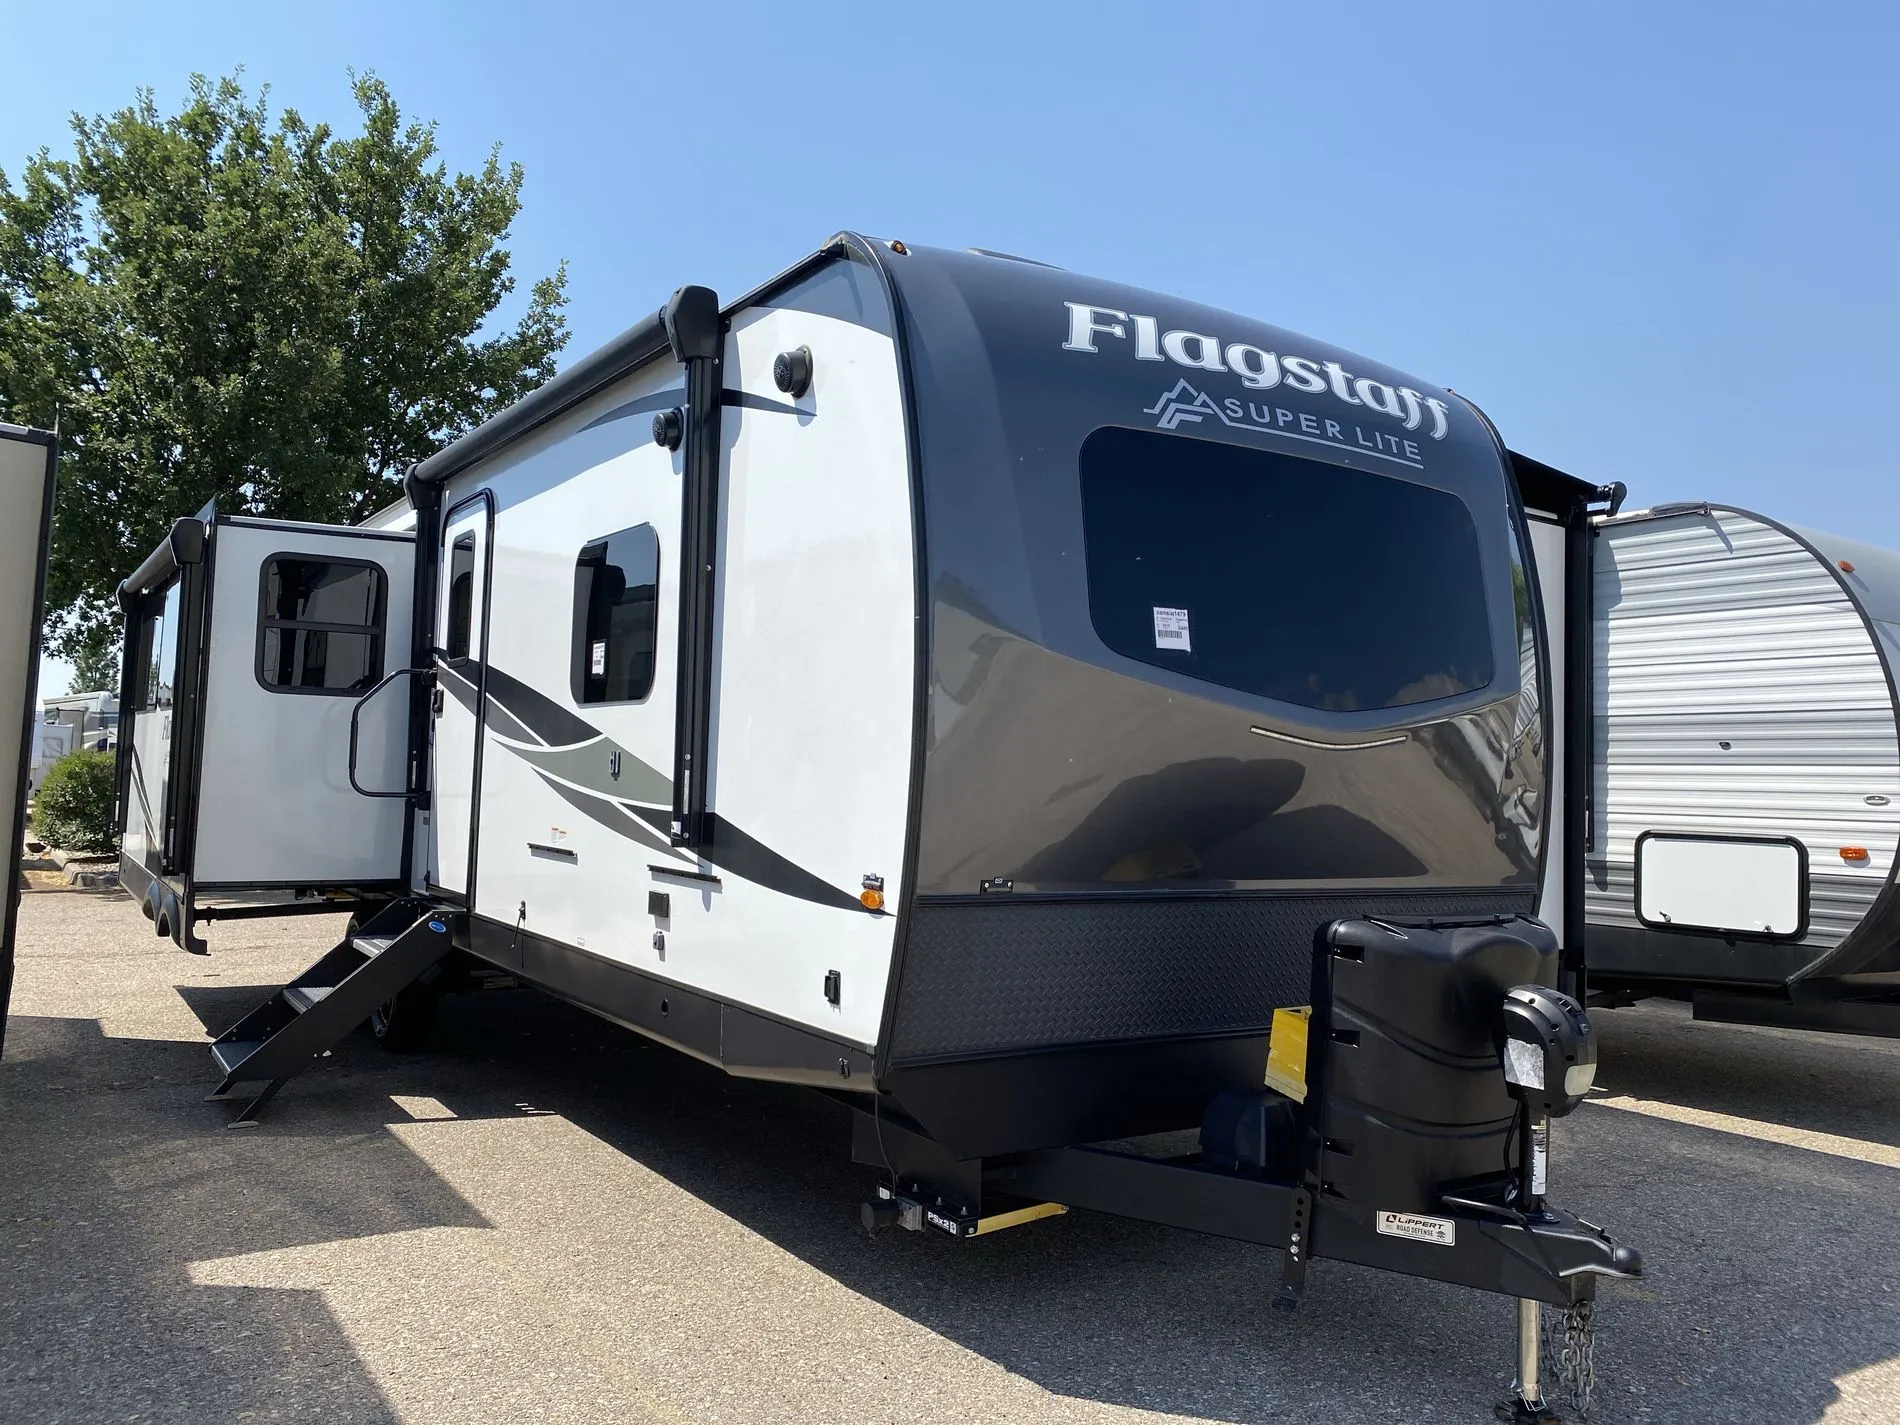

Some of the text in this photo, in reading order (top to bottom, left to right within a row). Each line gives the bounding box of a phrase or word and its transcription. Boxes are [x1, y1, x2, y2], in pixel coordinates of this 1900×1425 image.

[1061, 301, 1449, 441] Flagstaff
[1224, 398, 1422, 461] SUPER LITE
[1411, 1228, 1433, 1236] DEFENSE
